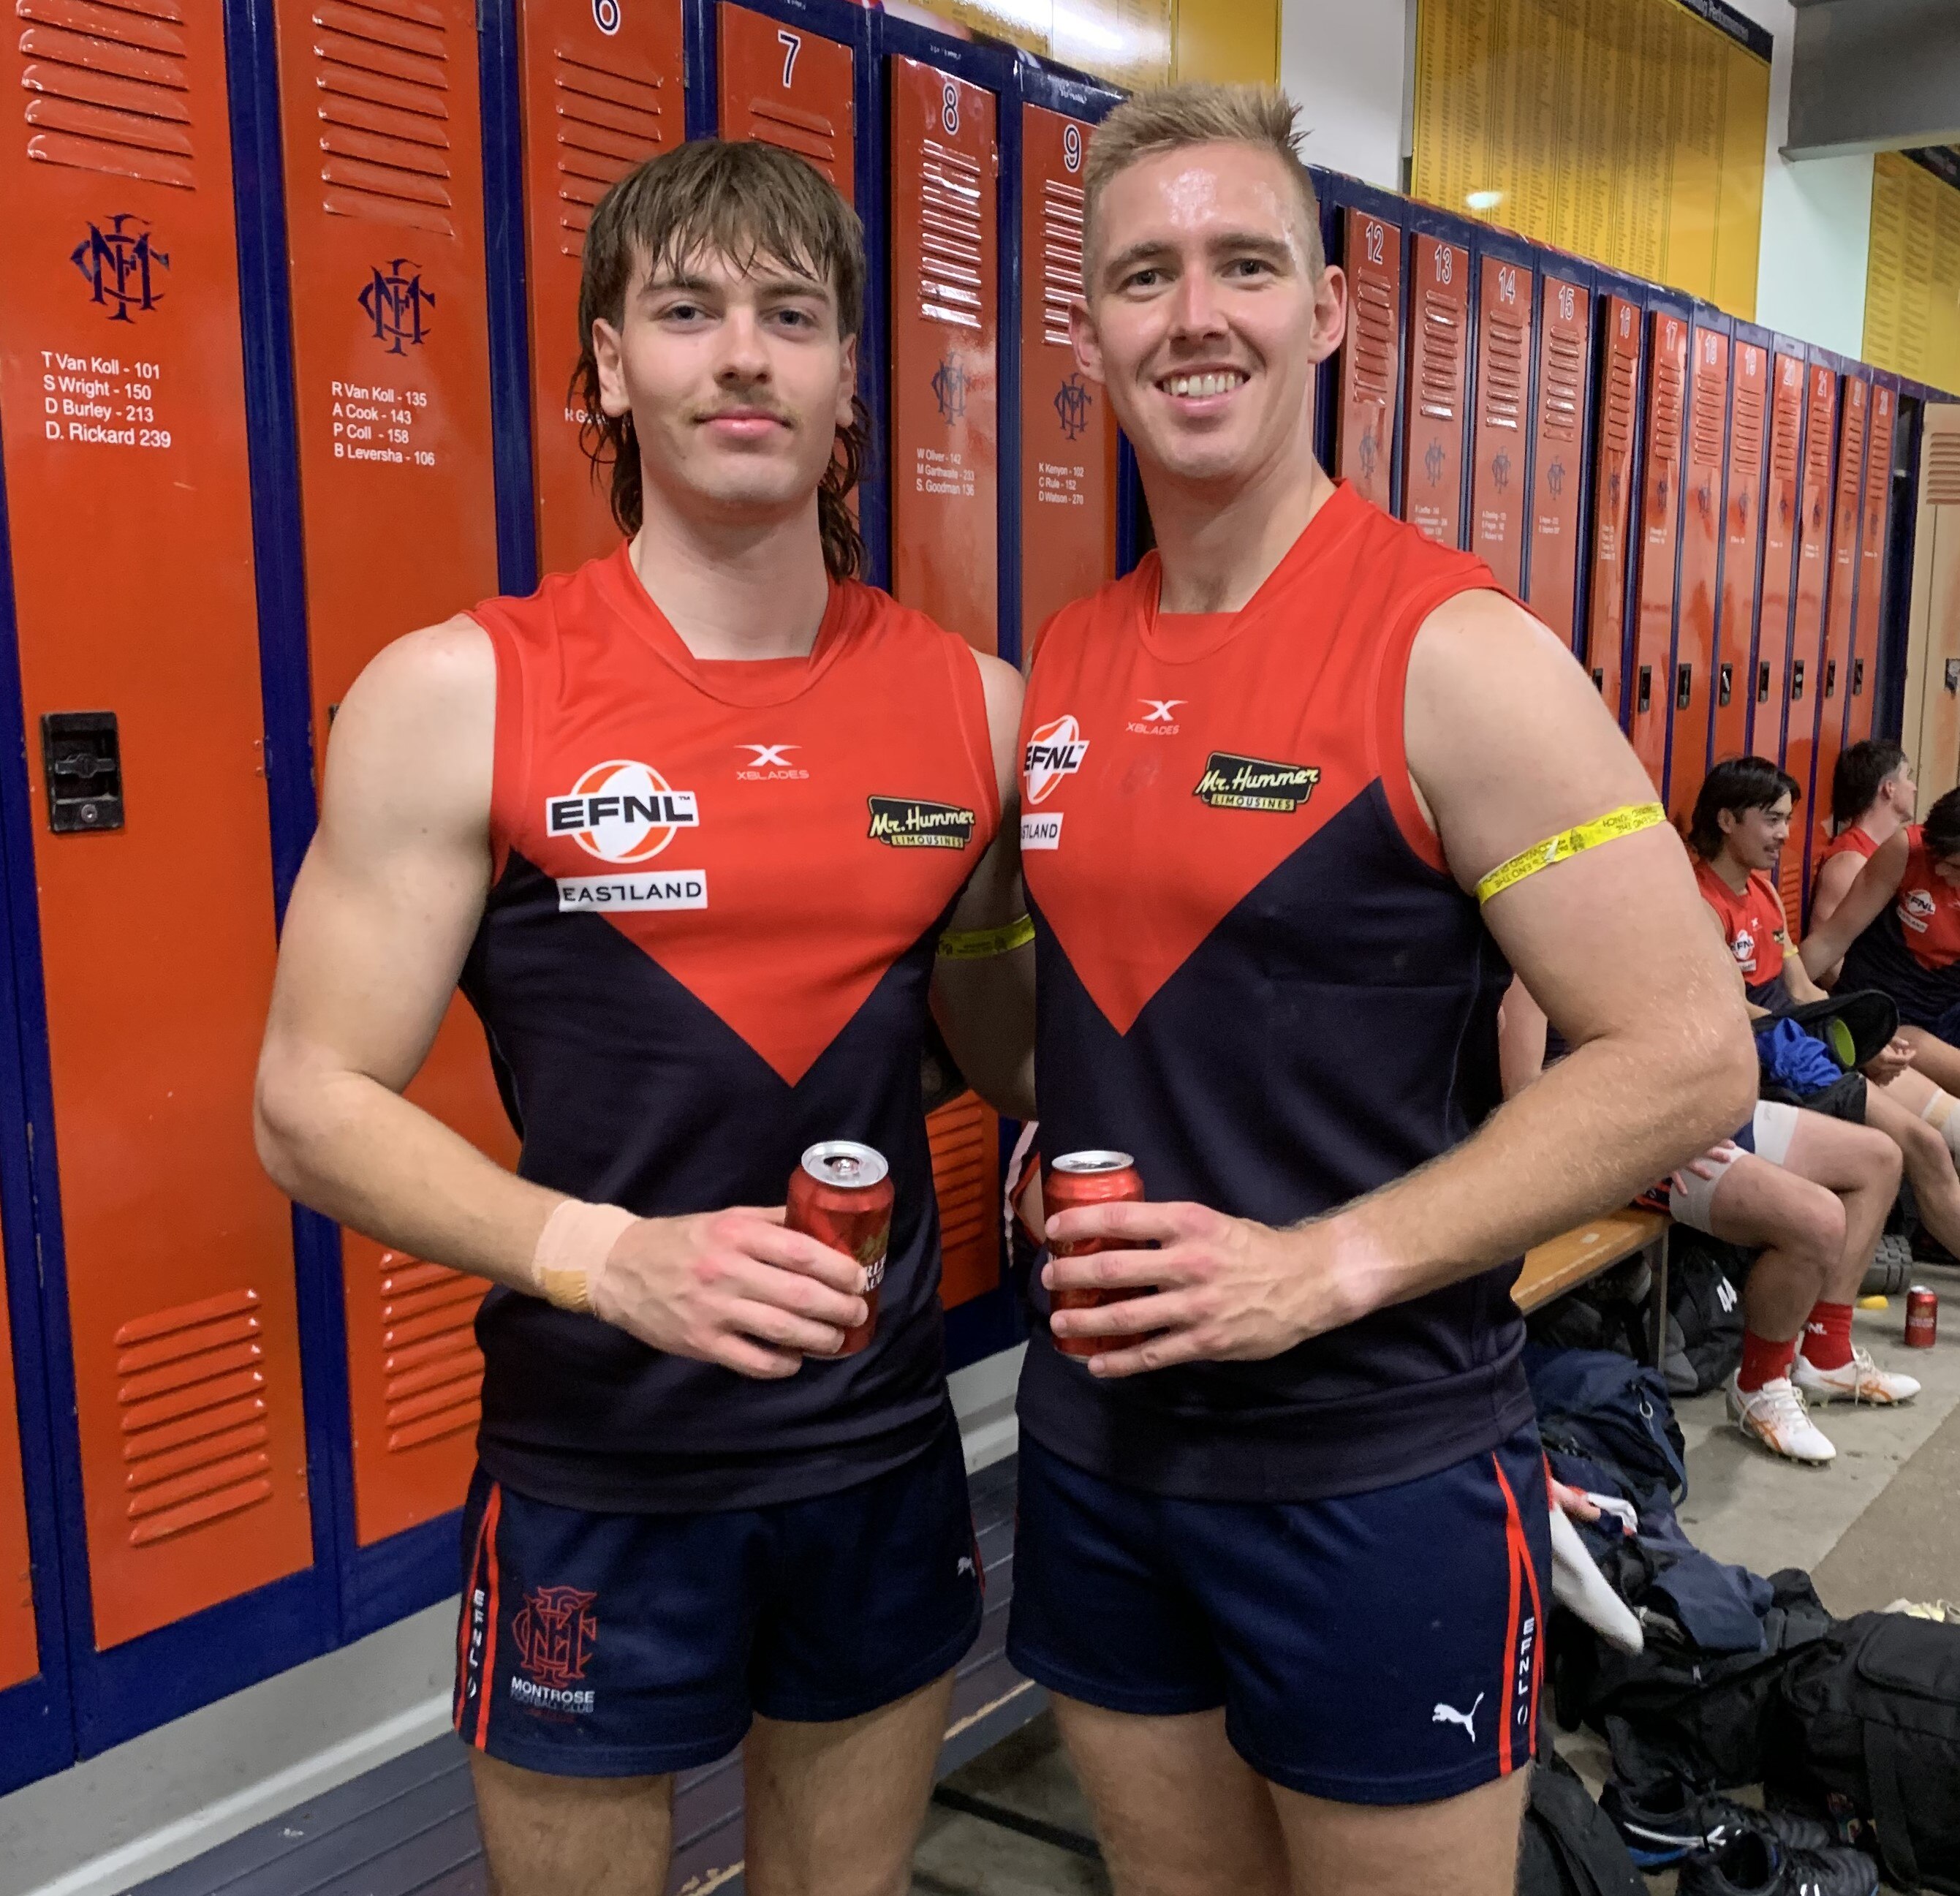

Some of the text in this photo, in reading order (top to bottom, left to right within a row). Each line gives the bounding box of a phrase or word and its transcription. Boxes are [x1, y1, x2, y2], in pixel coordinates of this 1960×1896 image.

[778, 29, 801, 88] 7
[942, 82, 961, 135] 8
[1064, 124, 1082, 173] 9
[1366, 221, 1384, 265] 12
[1434, 244, 1453, 285] 13
[1499, 266, 1516, 305] 14
[1559, 284, 1574, 321] 15
[1619, 305, 1631, 339] 16
[1666, 320, 1678, 352] 17
[41, 351, 53, 368] T
[56, 353, 86, 371] Van
[91, 356, 118, 375] Koll
[135, 361, 159, 379] 101
[43, 374, 56, 391] S
[58, 376, 110, 399] Wright
[124, 382, 151, 400] 150
[332, 381, 343, 396] R
[344, 382, 369, 399] Van
[372, 387, 395, 402] Koll
[406, 390, 428, 407] 135
[45, 397, 58, 414] D
[63, 399, 112, 422] Burley
[126, 404, 154, 423] 213
[332, 402, 344, 417] A
[346, 404, 379, 420] Cook
[390, 409, 412, 425] 143
[45, 420, 171, 448] D. Rickard 239
[333, 422, 344, 437] P
[347, 423, 371, 440] Coll
[387, 428, 409, 444] 158
[334, 442, 344, 458] B
[347, 444, 403, 463] Leversha
[414, 450, 436, 466] 106
[926, 479, 960, 495] Goodman
[1126, 722, 1179, 736] XBLADES
[736, 769, 809, 781] XBLADES
[1195, 764, 1319, 794] Mr. Hummer
[551, 796, 694, 831] EFNL
[1214, 795, 1293, 811] LIMOUSINES
[869, 805, 975, 837] Mr. Hummer
[894, 835, 963, 848] LIMOUSINES
[563, 882, 702, 902] EASTLAND
[1518, 1616, 1535, 1696] EFNL
[511, 1675, 596, 1704] MONTROSE
